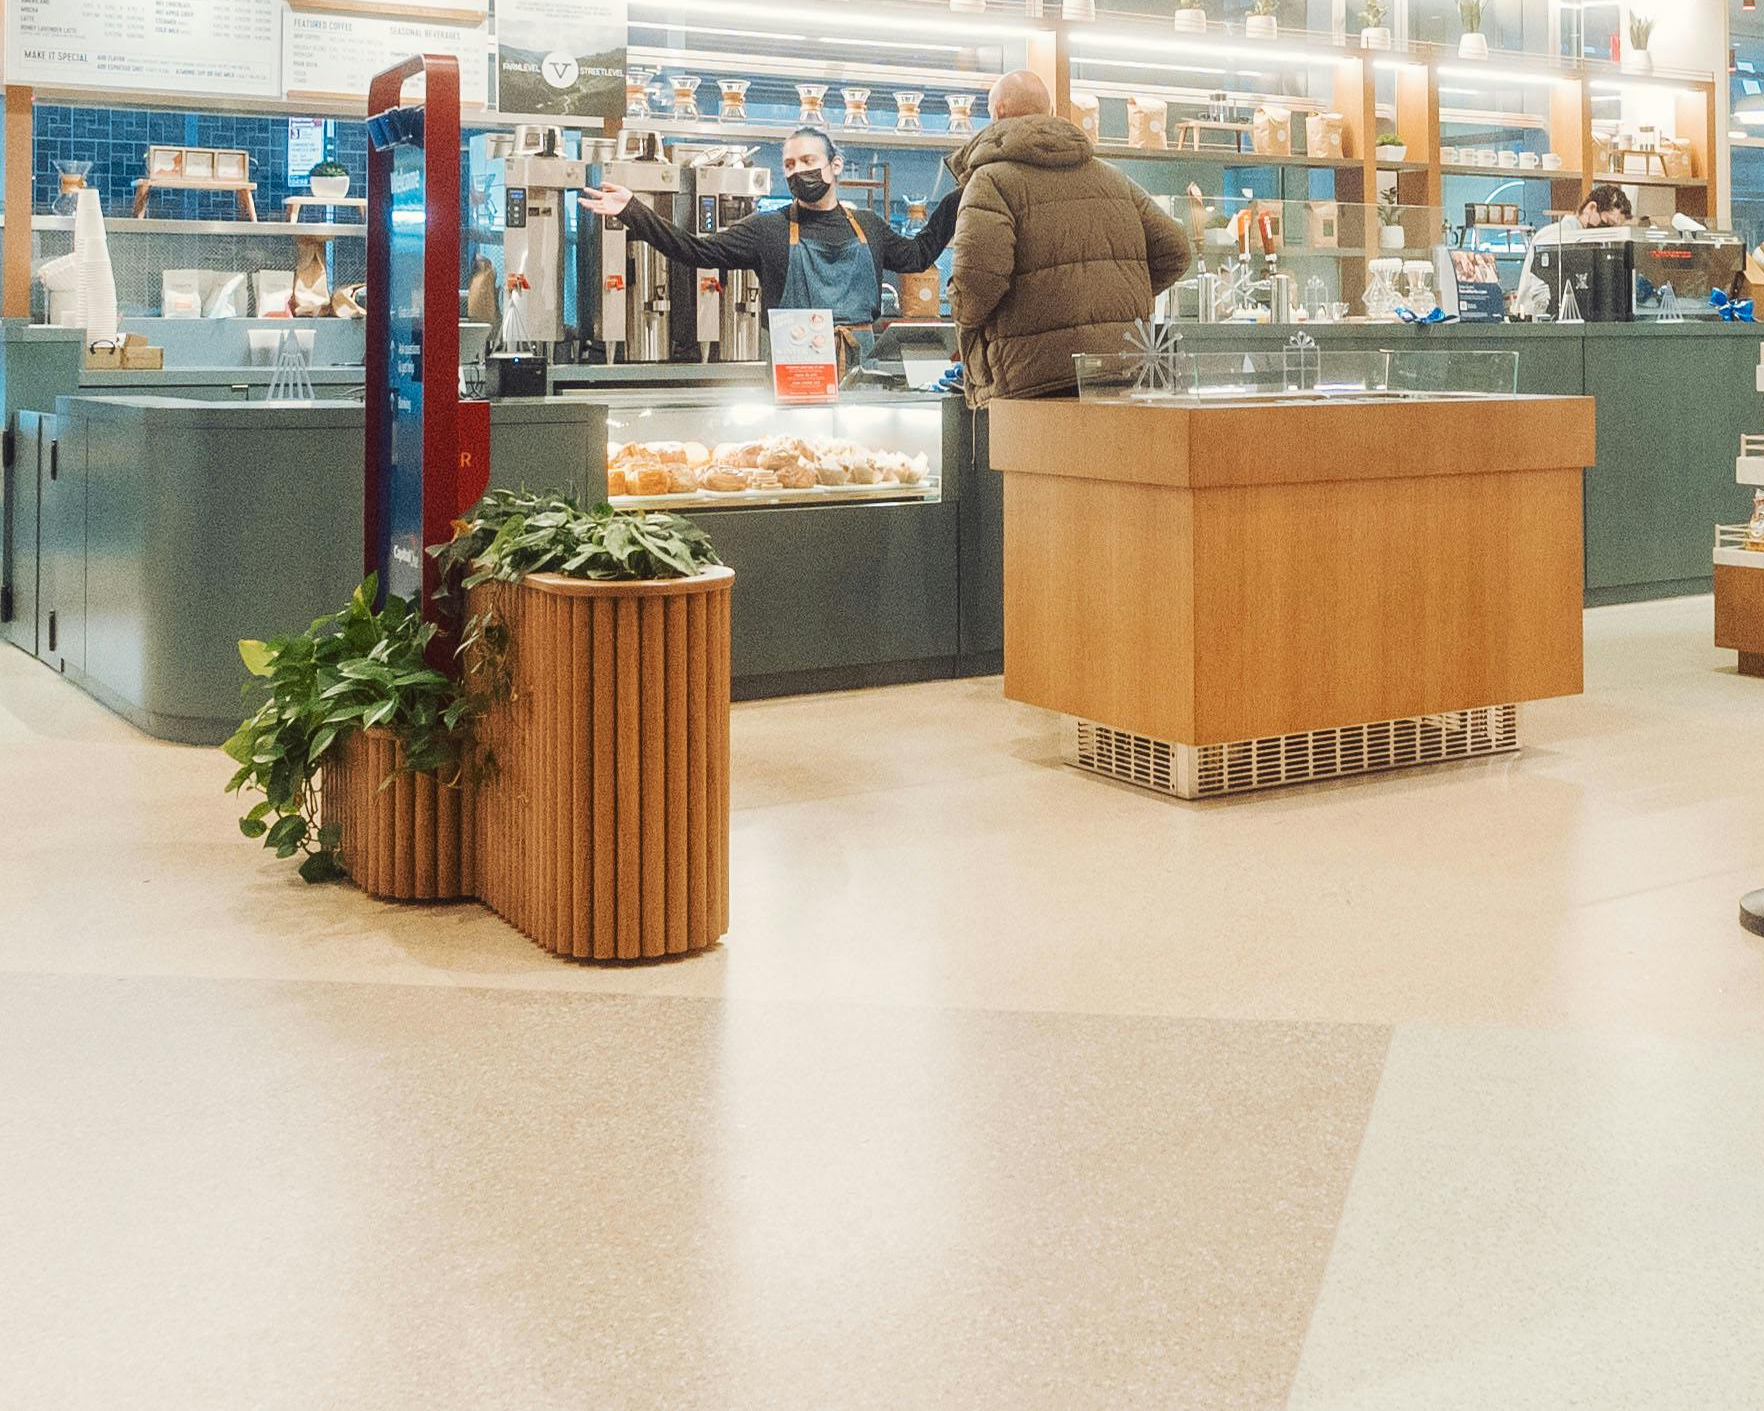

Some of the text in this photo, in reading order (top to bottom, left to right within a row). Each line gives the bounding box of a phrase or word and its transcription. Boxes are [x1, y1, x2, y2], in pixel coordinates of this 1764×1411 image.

[293, 18, 353, 32] FEATURED COFFEE
[24, 50, 89, 62] MAKE IT SPECIAL
[502, 61, 626, 79] FARMLEVEL V STREETLEVEL
